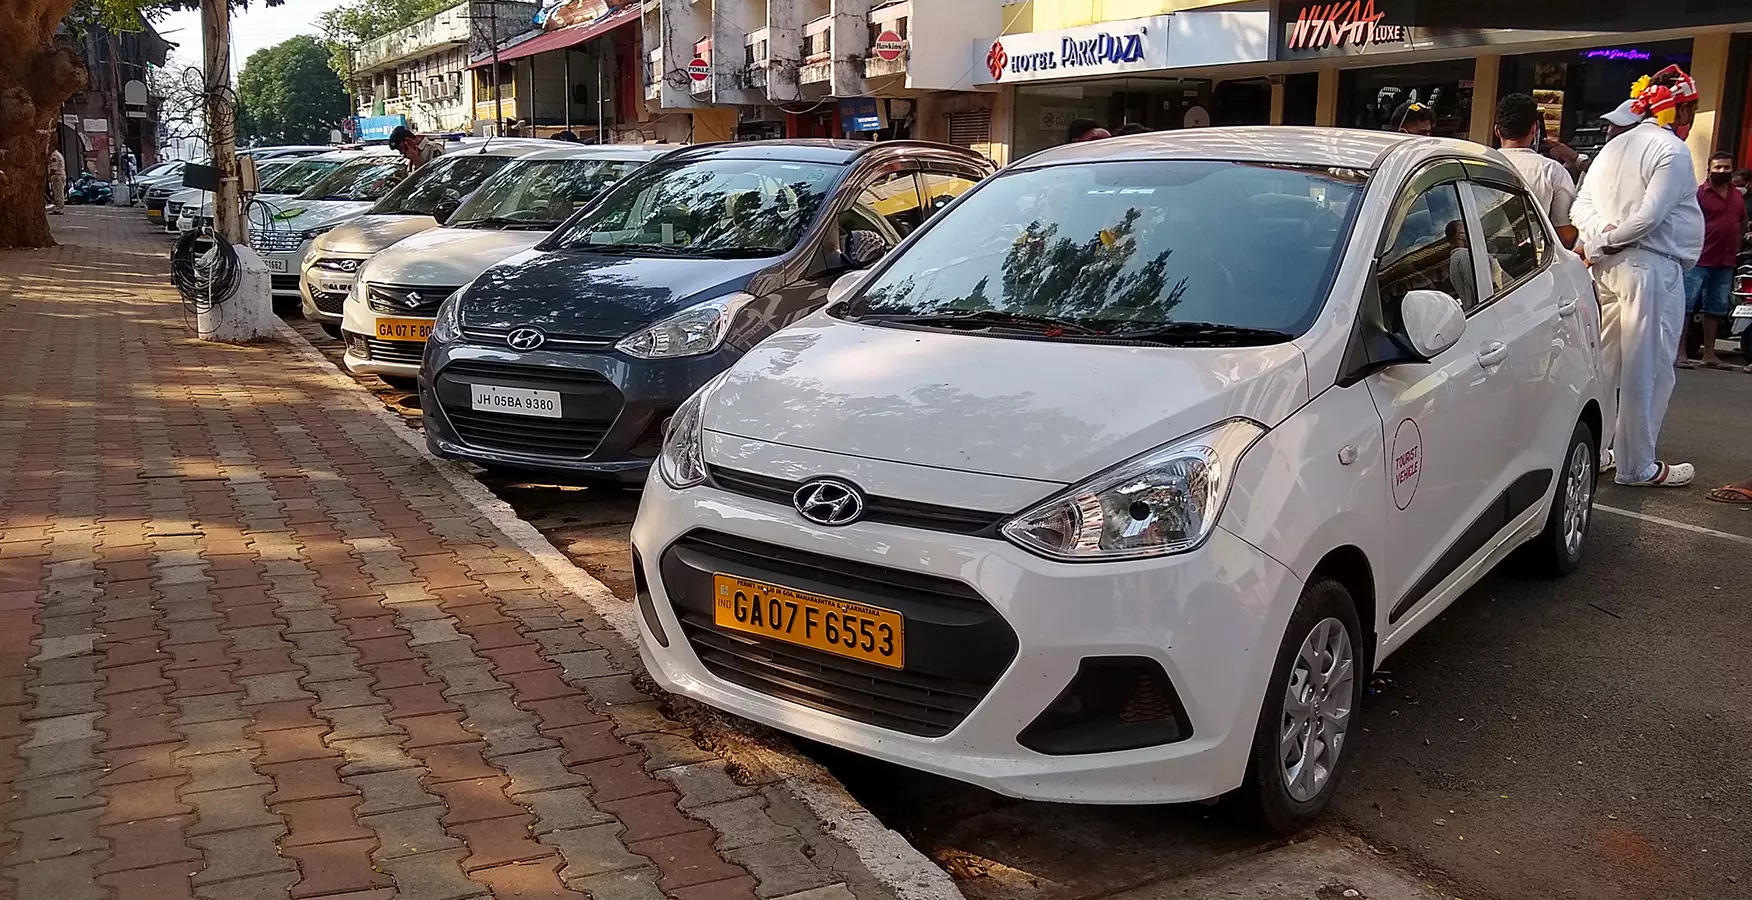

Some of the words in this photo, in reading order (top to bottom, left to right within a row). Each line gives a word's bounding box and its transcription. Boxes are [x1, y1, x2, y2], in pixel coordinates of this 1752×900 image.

[1288, 0, 1384, 50] NYKAA
[1375, 25, 1401, 41] LUXE
[1011, 51, 1057, 73] HOTEL
[379, 323, 393, 336] GA
[395, 324, 407, 337] 07
[410, 325, 417, 337] F
[419, 325, 434, 338] 80
[477, 394, 491, 405] JH
[494, 395, 522, 408] 05BA
[525, 398, 554, 411] 9380
[1395, 445, 1418, 470] TOURIST
[1395, 461, 1418, 487] VEHICLE
[717, 598, 732, 610] IND
[736, 580, 756, 589] PERMIT
[795, 592, 836, 608] MAHARASHTRA
[846, 604, 881, 617] KARNATAKA
